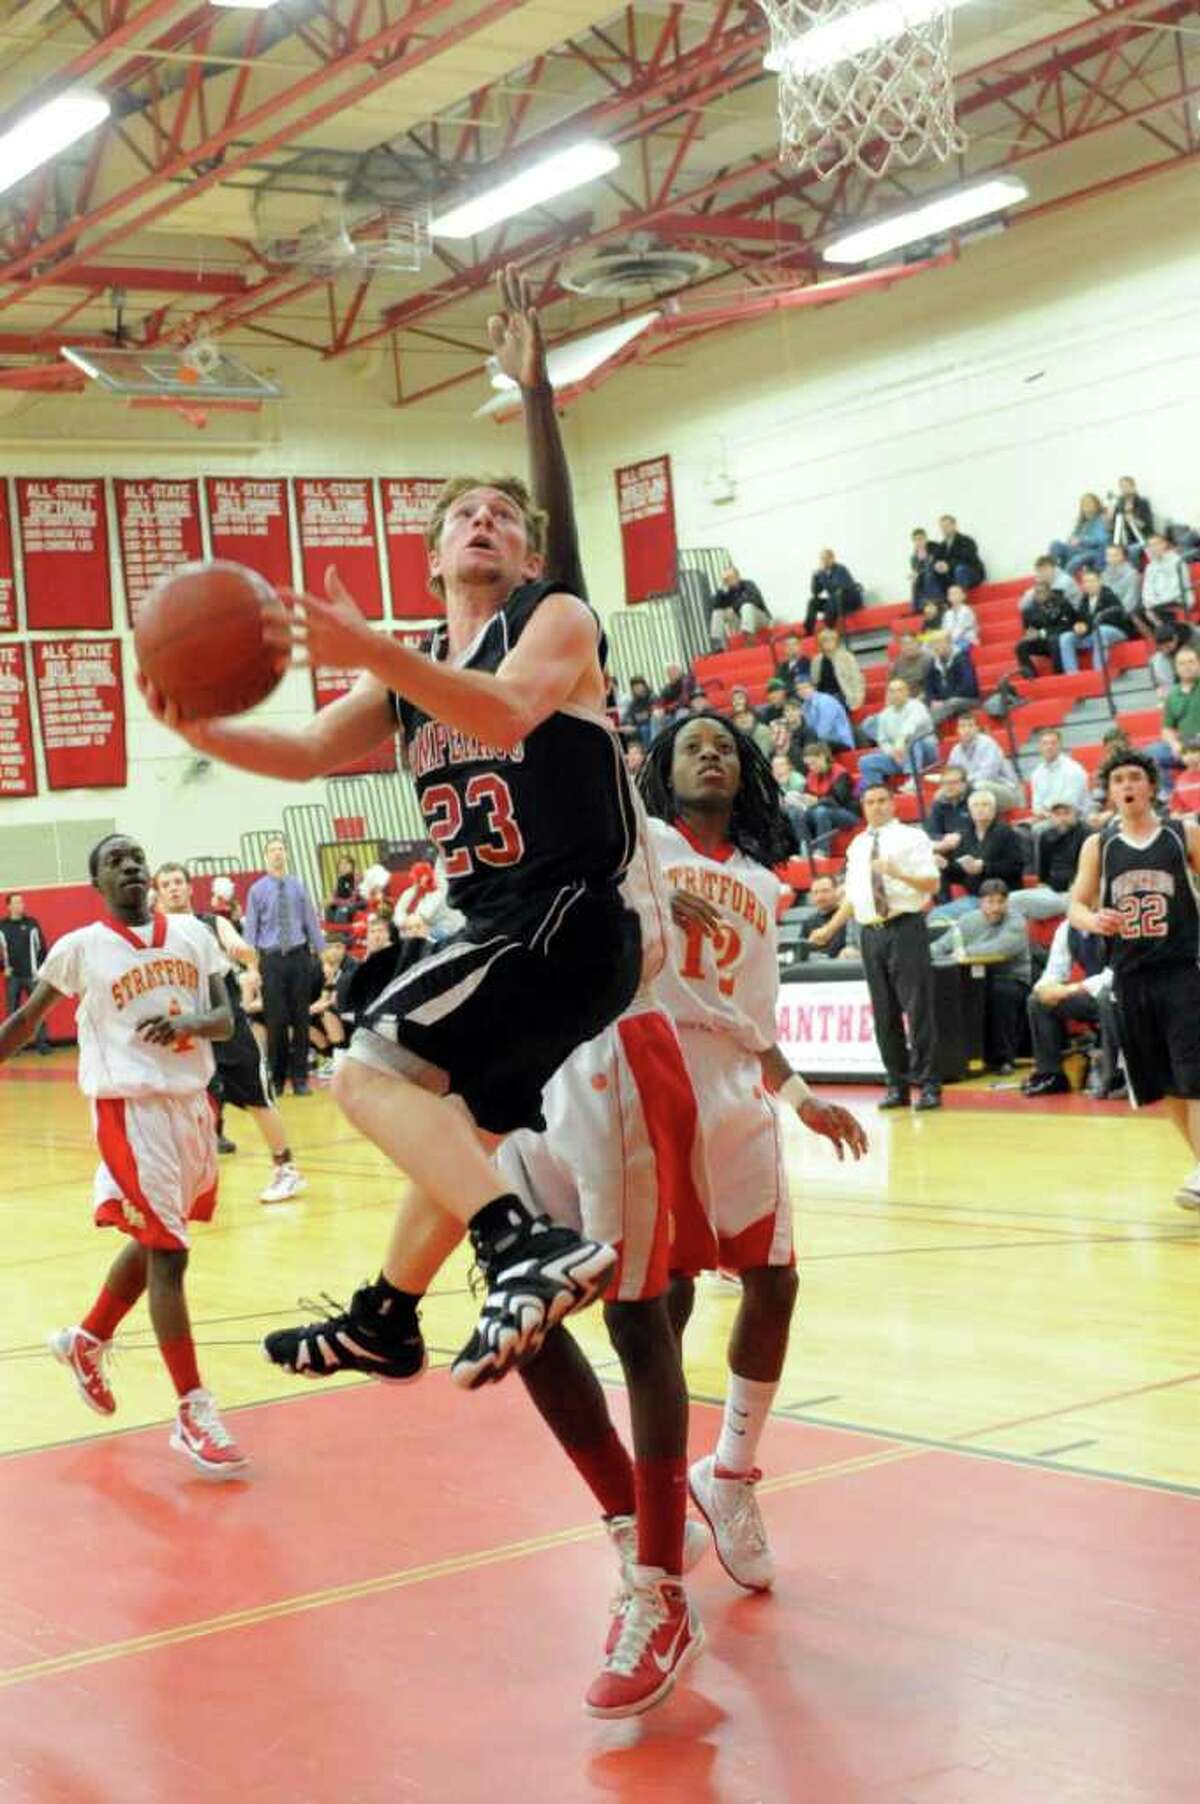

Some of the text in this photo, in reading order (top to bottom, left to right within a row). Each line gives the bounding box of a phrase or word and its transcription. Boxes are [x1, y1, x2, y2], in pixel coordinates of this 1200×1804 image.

[421, 772, 524, 878] 23
[667, 866, 768, 936] TRTFORD
[1119, 894, 1169, 939] 22
[111, 958, 200, 1012] STRATFORD
